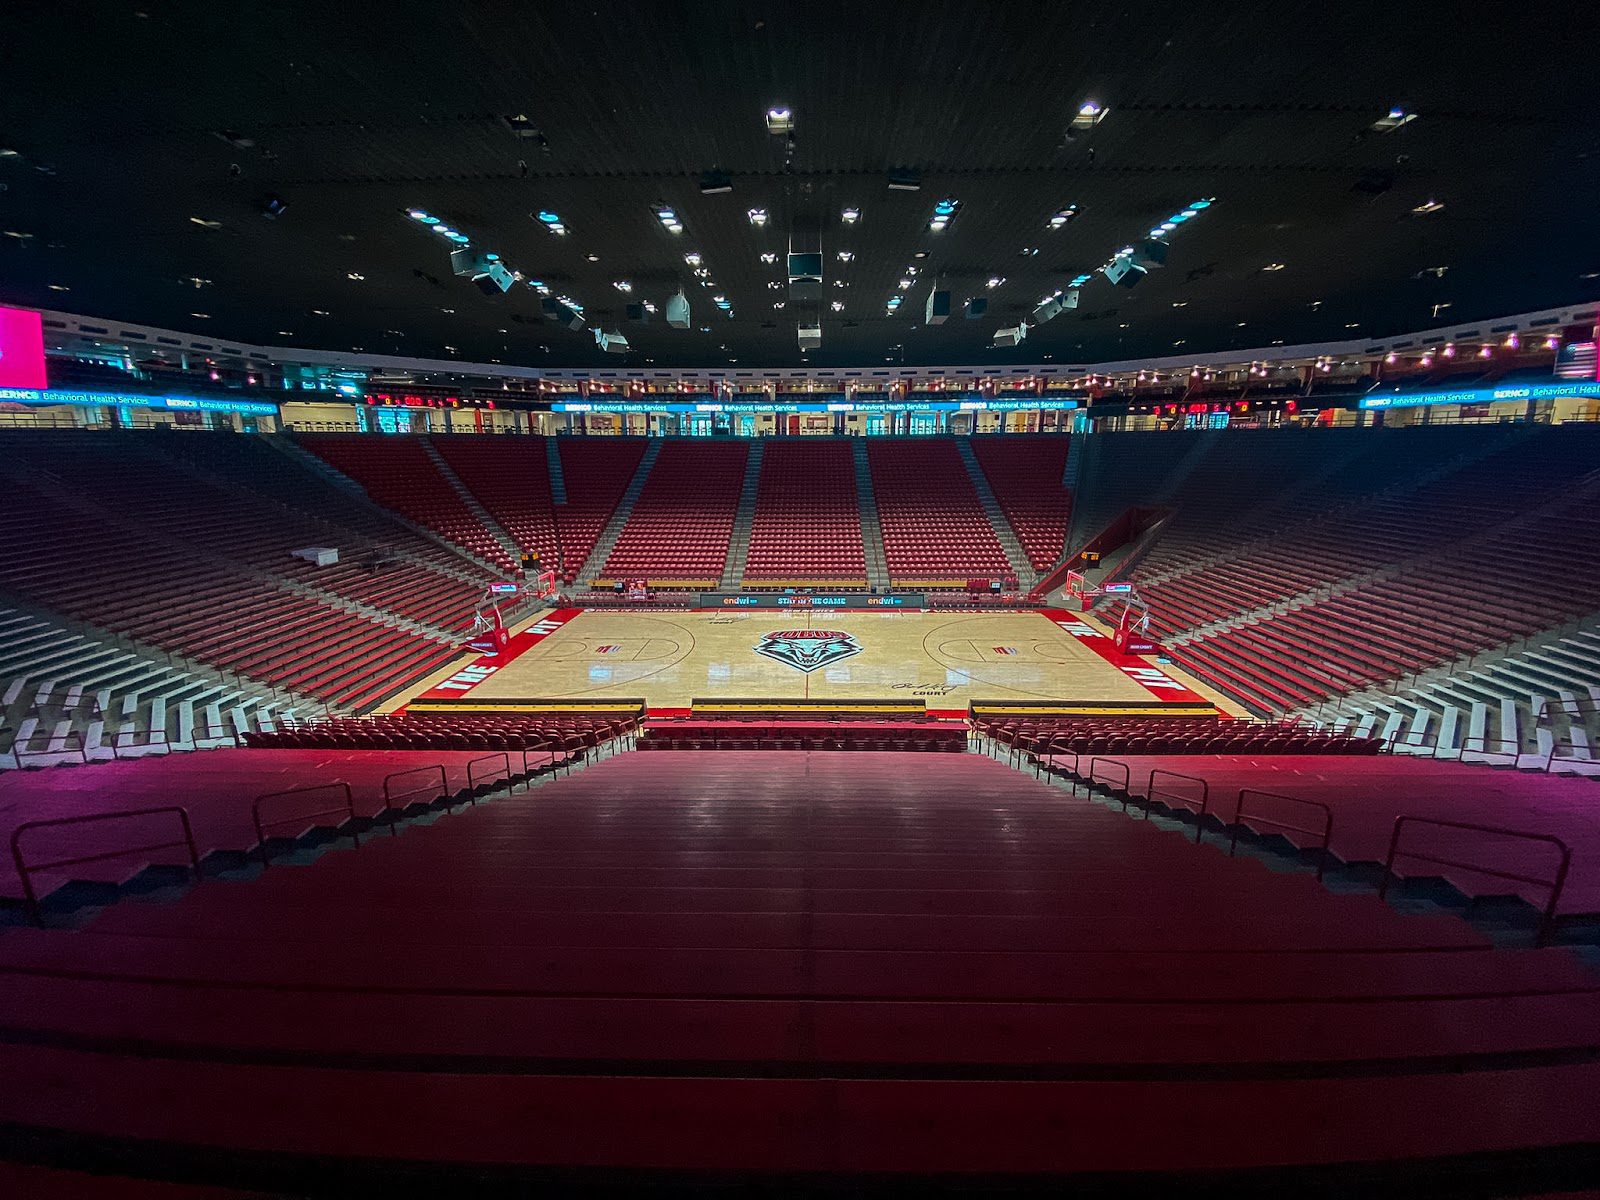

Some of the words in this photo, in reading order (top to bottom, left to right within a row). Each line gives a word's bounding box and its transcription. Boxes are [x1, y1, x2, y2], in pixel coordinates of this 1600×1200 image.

[1533, 386, 1577, 396] Behavioral
[43, 393, 88, 402] Behavioral
[90, 395, 116, 404] Health
[118, 396, 148, 405] Services
[1392, 397, 1423, 405] Behavioral
[1447, 393, 1475, 401] Services
[200, 401, 230, 409] Behavioral
[231, 402, 251, 410] Health
[251, 404, 273, 412] Services
[724, 404, 753, 412] Behavioral
[434, 665, 499, 690] THE
[523, 619, 565, 635] PIT
[1056, 621, 1105, 638] THE
[1120, 667, 1188, 690] PIT
